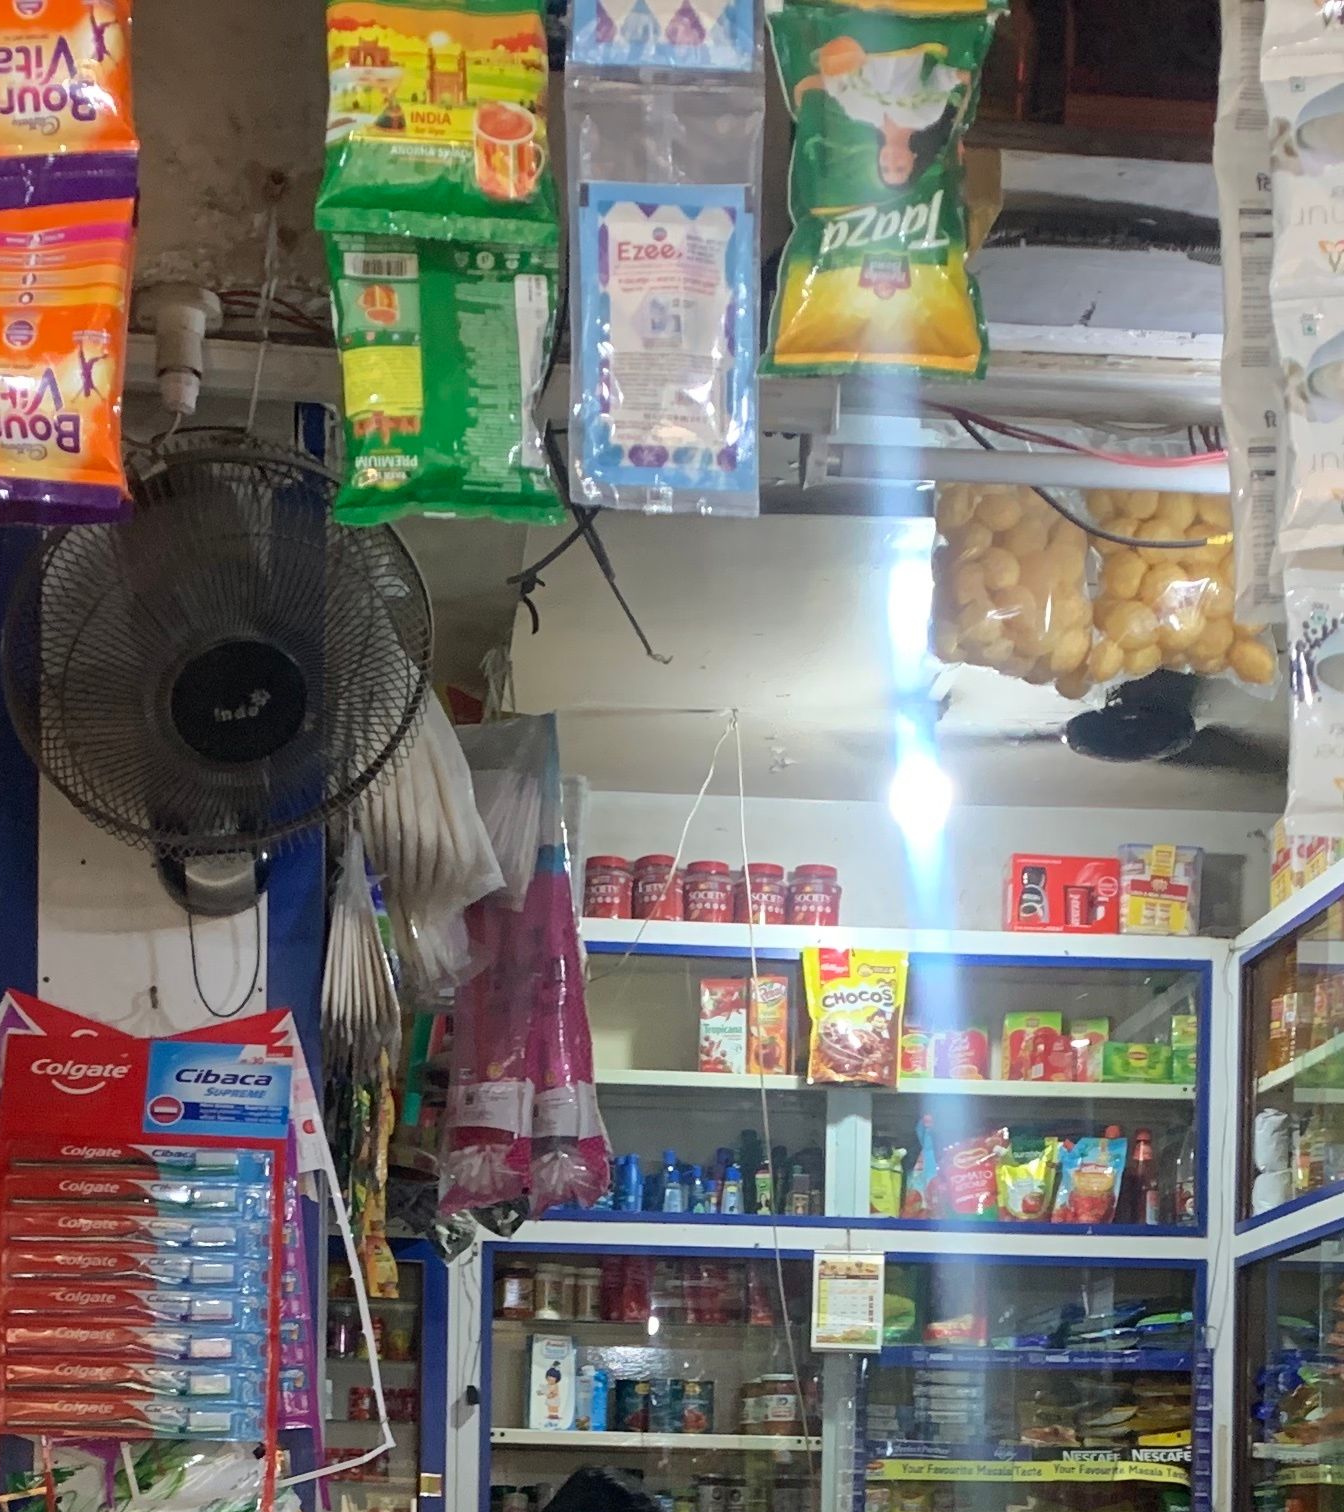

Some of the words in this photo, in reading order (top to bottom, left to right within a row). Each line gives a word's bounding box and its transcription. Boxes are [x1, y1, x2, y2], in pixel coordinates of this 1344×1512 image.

[410, 111, 452, 126] INDIA
[819, 188, 950, 255] Taaza
[355, 454, 419, 468] PREMIUM
[688, 891, 728, 902] SOCIETY
[793, 893, 832, 904] SOCIETY
[821, 988, 896, 1009] CHOCOS
[30, 1057, 131, 1081] Colgate
[175, 1068, 273, 1087] Cibaca
[203, 1086, 268, 1099] SUPREME
[60, 1144, 122, 1160] Colgate
[58, 1179, 121, 1196] Colgate
[57, 1216, 119, 1232] Colgate
[56, 1252, 118, 1269] Colgate
[55, 1290, 117, 1305] Colgate
[55, 1401, 114, 1417] Colgate
[901, 1463, 924, 1475] Your
[1014, 1465, 1043, 1477] Taste
[1053, 1463, 1076, 1475] Your
[1128, 1465, 1163, 1477] Masala
